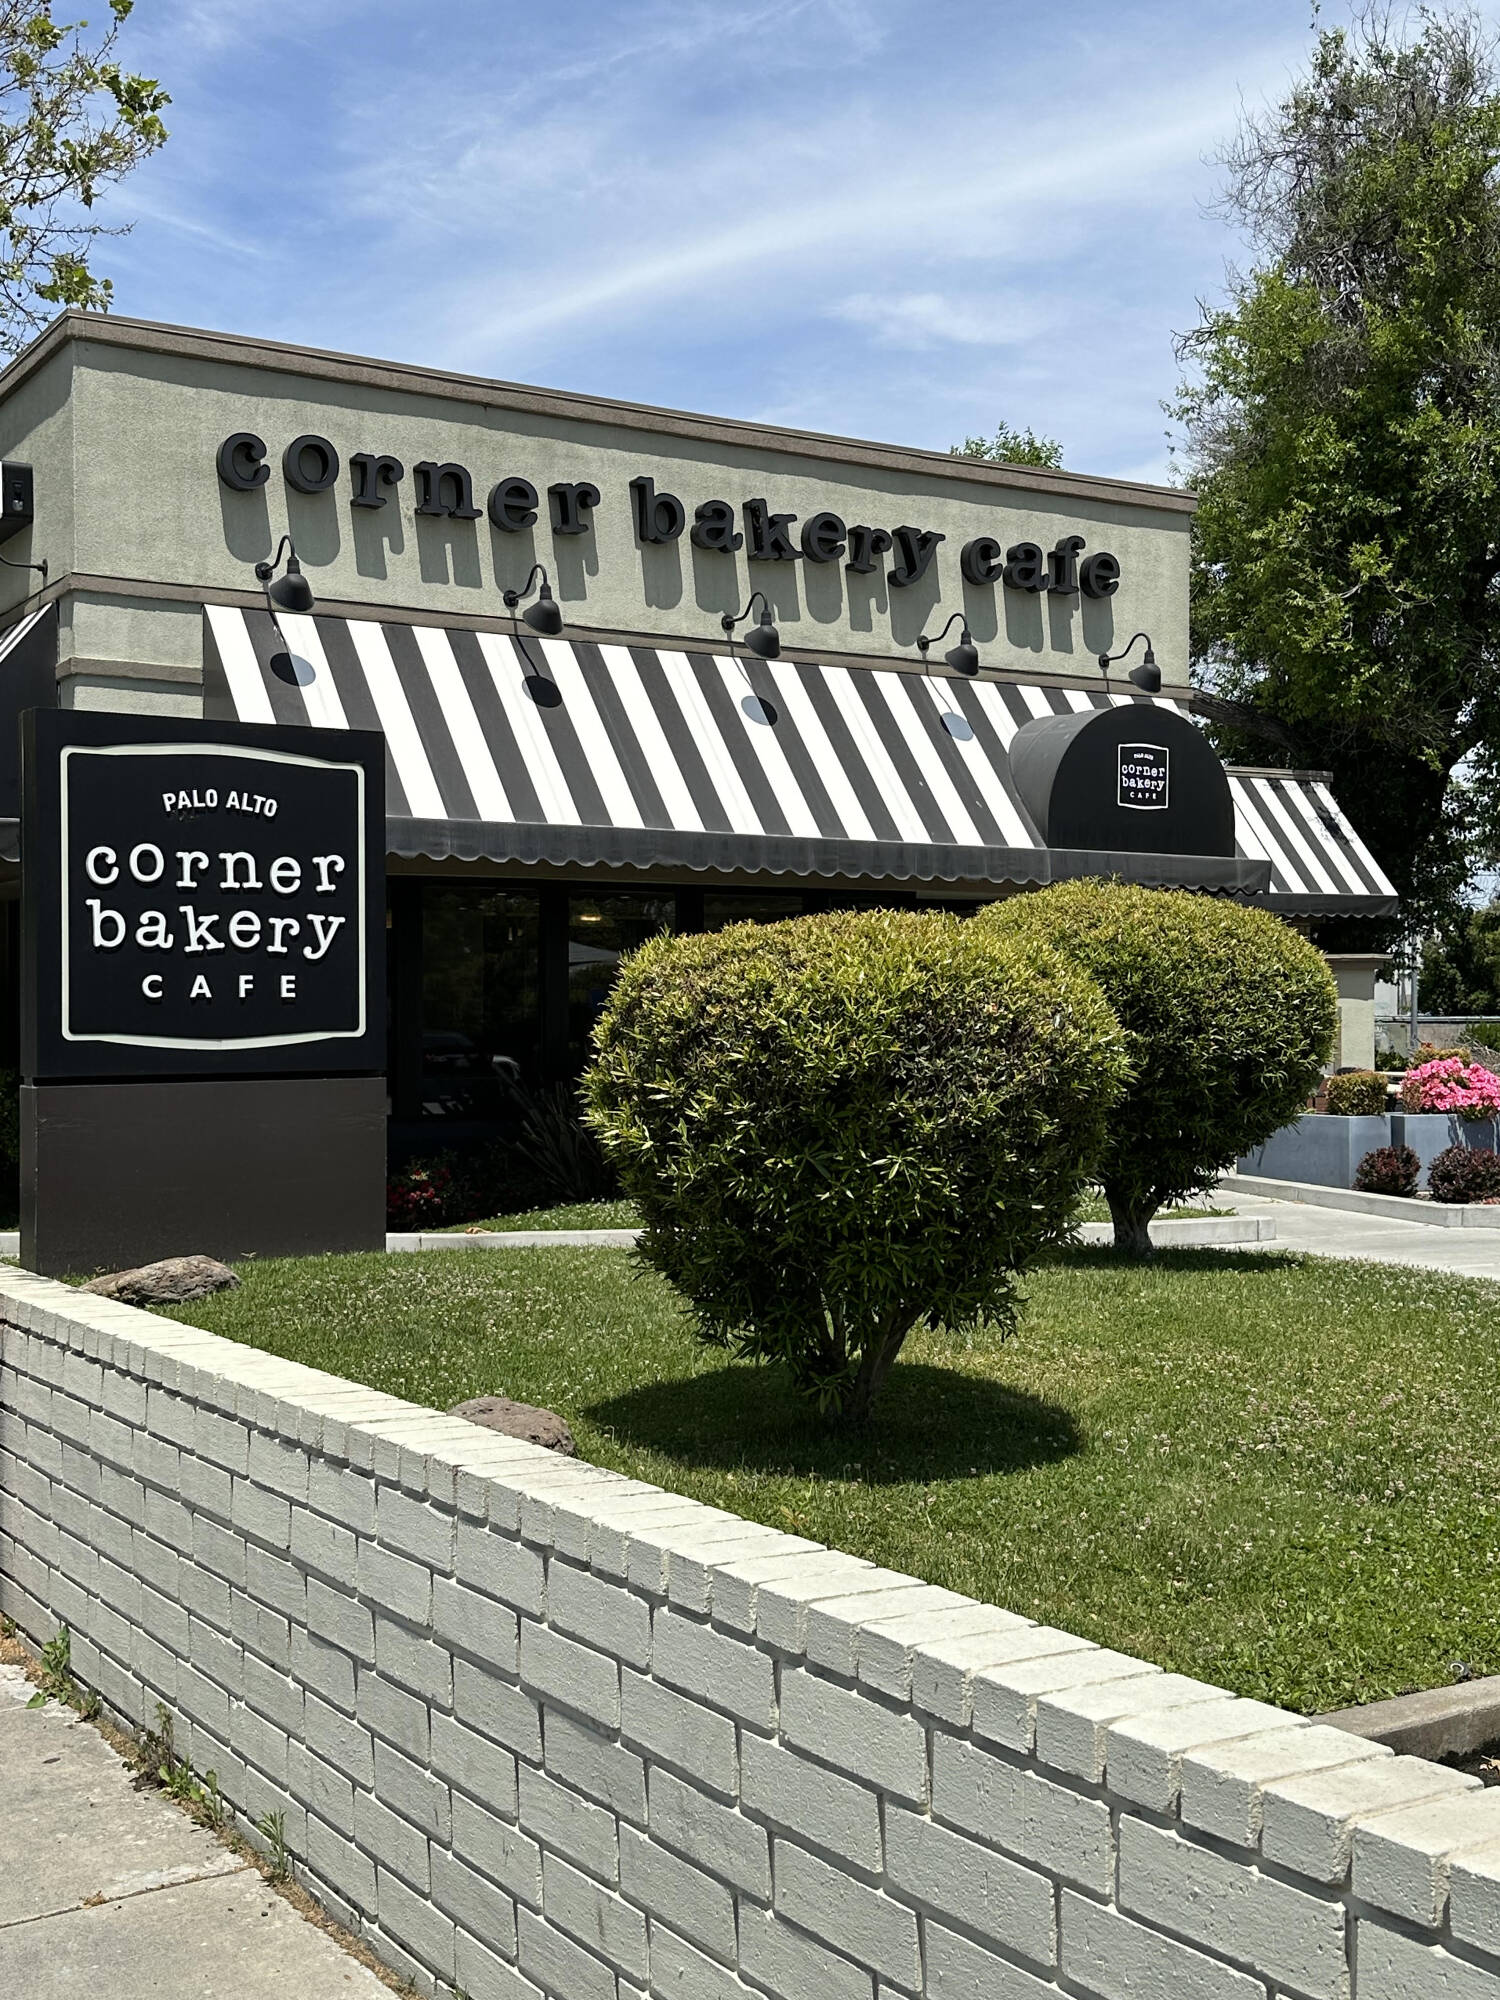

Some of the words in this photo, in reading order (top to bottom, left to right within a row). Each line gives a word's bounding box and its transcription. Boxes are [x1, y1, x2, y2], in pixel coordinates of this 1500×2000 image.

[217, 432, 600, 534] corner
[629, 476, 946, 587] bakery
[960, 535, 1120, 598] cafe
[1121, 764, 1165, 777] corner
[1121, 775, 1165, 791] bakery
[162, 789, 218, 812] PALO
[226, 790, 278, 817] ALTO
[1129, 791, 1157, 799] CAFE
[85, 843, 345, 894] corner
[85, 898, 345, 959] bakery
[142, 974, 297, 998] CAFE
